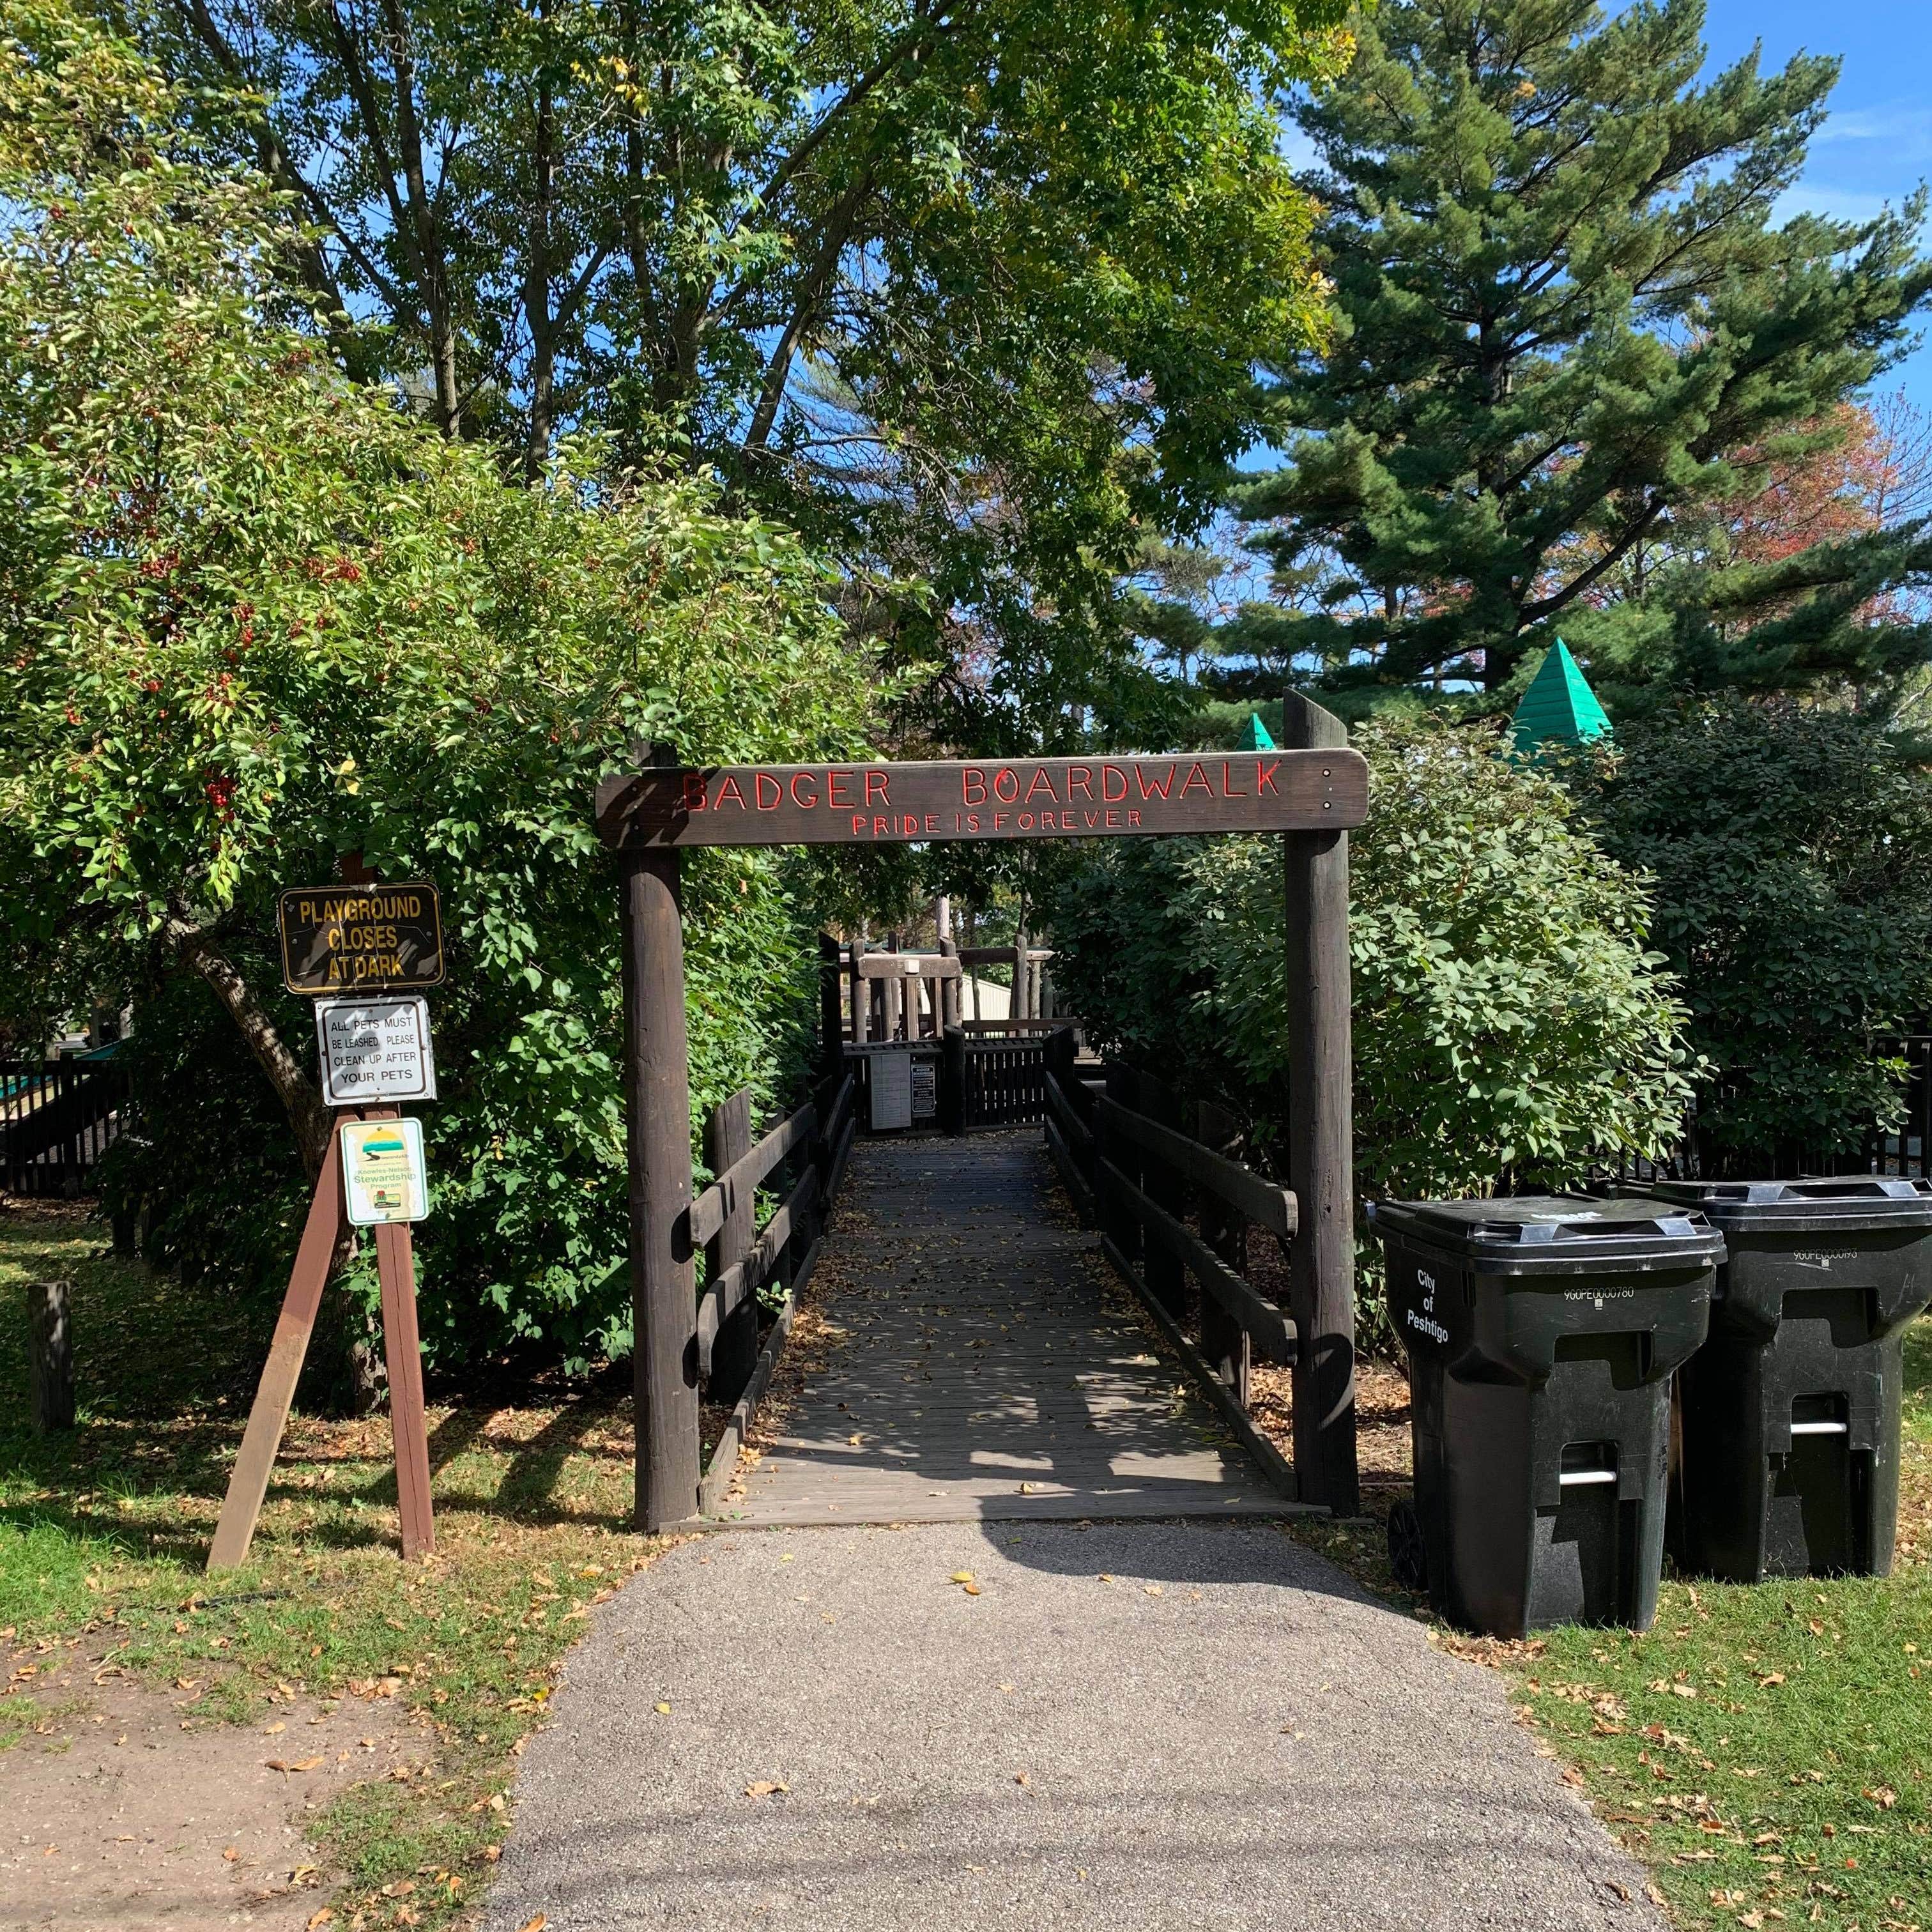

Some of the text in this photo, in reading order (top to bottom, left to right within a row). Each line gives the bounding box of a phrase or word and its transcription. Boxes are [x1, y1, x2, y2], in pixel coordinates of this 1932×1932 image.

[683, 759, 1283, 811] BADGER BOARDWALK
[852, 809, 1142, 836] PRIDE IS FOREVER
[299, 895, 422, 924] PLAYGROUND
[327, 925, 398, 951] CLOSES
[328, 954, 406, 981] AT DARK
[331, 1016, 413, 1032] ALL PETS MUST
[332, 1039, 342, 1050] BE
[387, 1034, 415, 1045] PLEASE
[334, 1052, 417, 1066] CLEAN UP AFTER
[341, 1069, 413, 1084] YOUR PETS
[353, 1172, 417, 1184] Stewardship
[1418, 1269, 1436, 1294] City
[1423, 1296, 1434, 1312] of
[1407, 1308, 1448, 1344] Peshtigo
